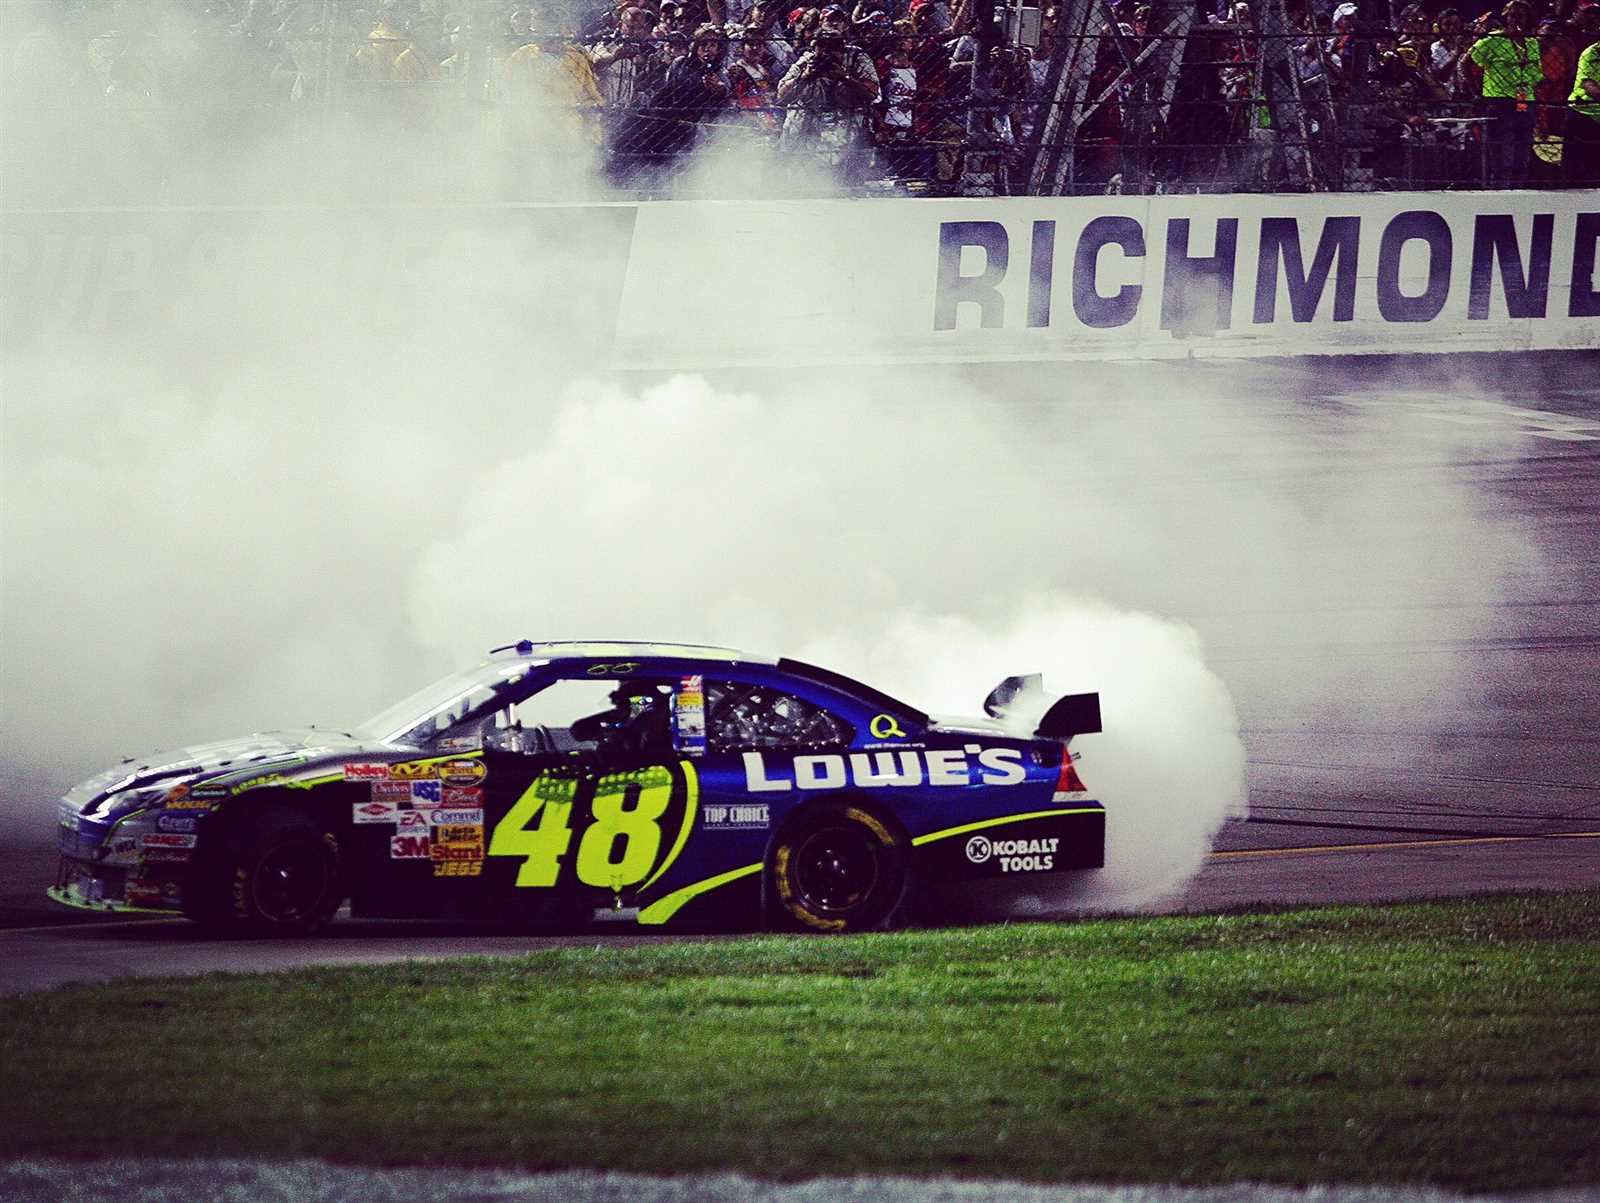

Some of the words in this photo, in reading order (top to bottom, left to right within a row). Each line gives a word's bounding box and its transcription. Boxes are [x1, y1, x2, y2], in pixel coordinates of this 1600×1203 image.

[742, 744, 1027, 792] LOWE'S
[703, 807, 728, 823] TOP
[730, 806, 770, 823] CHOICE
[488, 764, 674, 888] 48
[392, 836, 430, 857] 3M
[992, 838, 1059, 856] KOBALT
[1000, 855, 1054, 873] TOOLS
